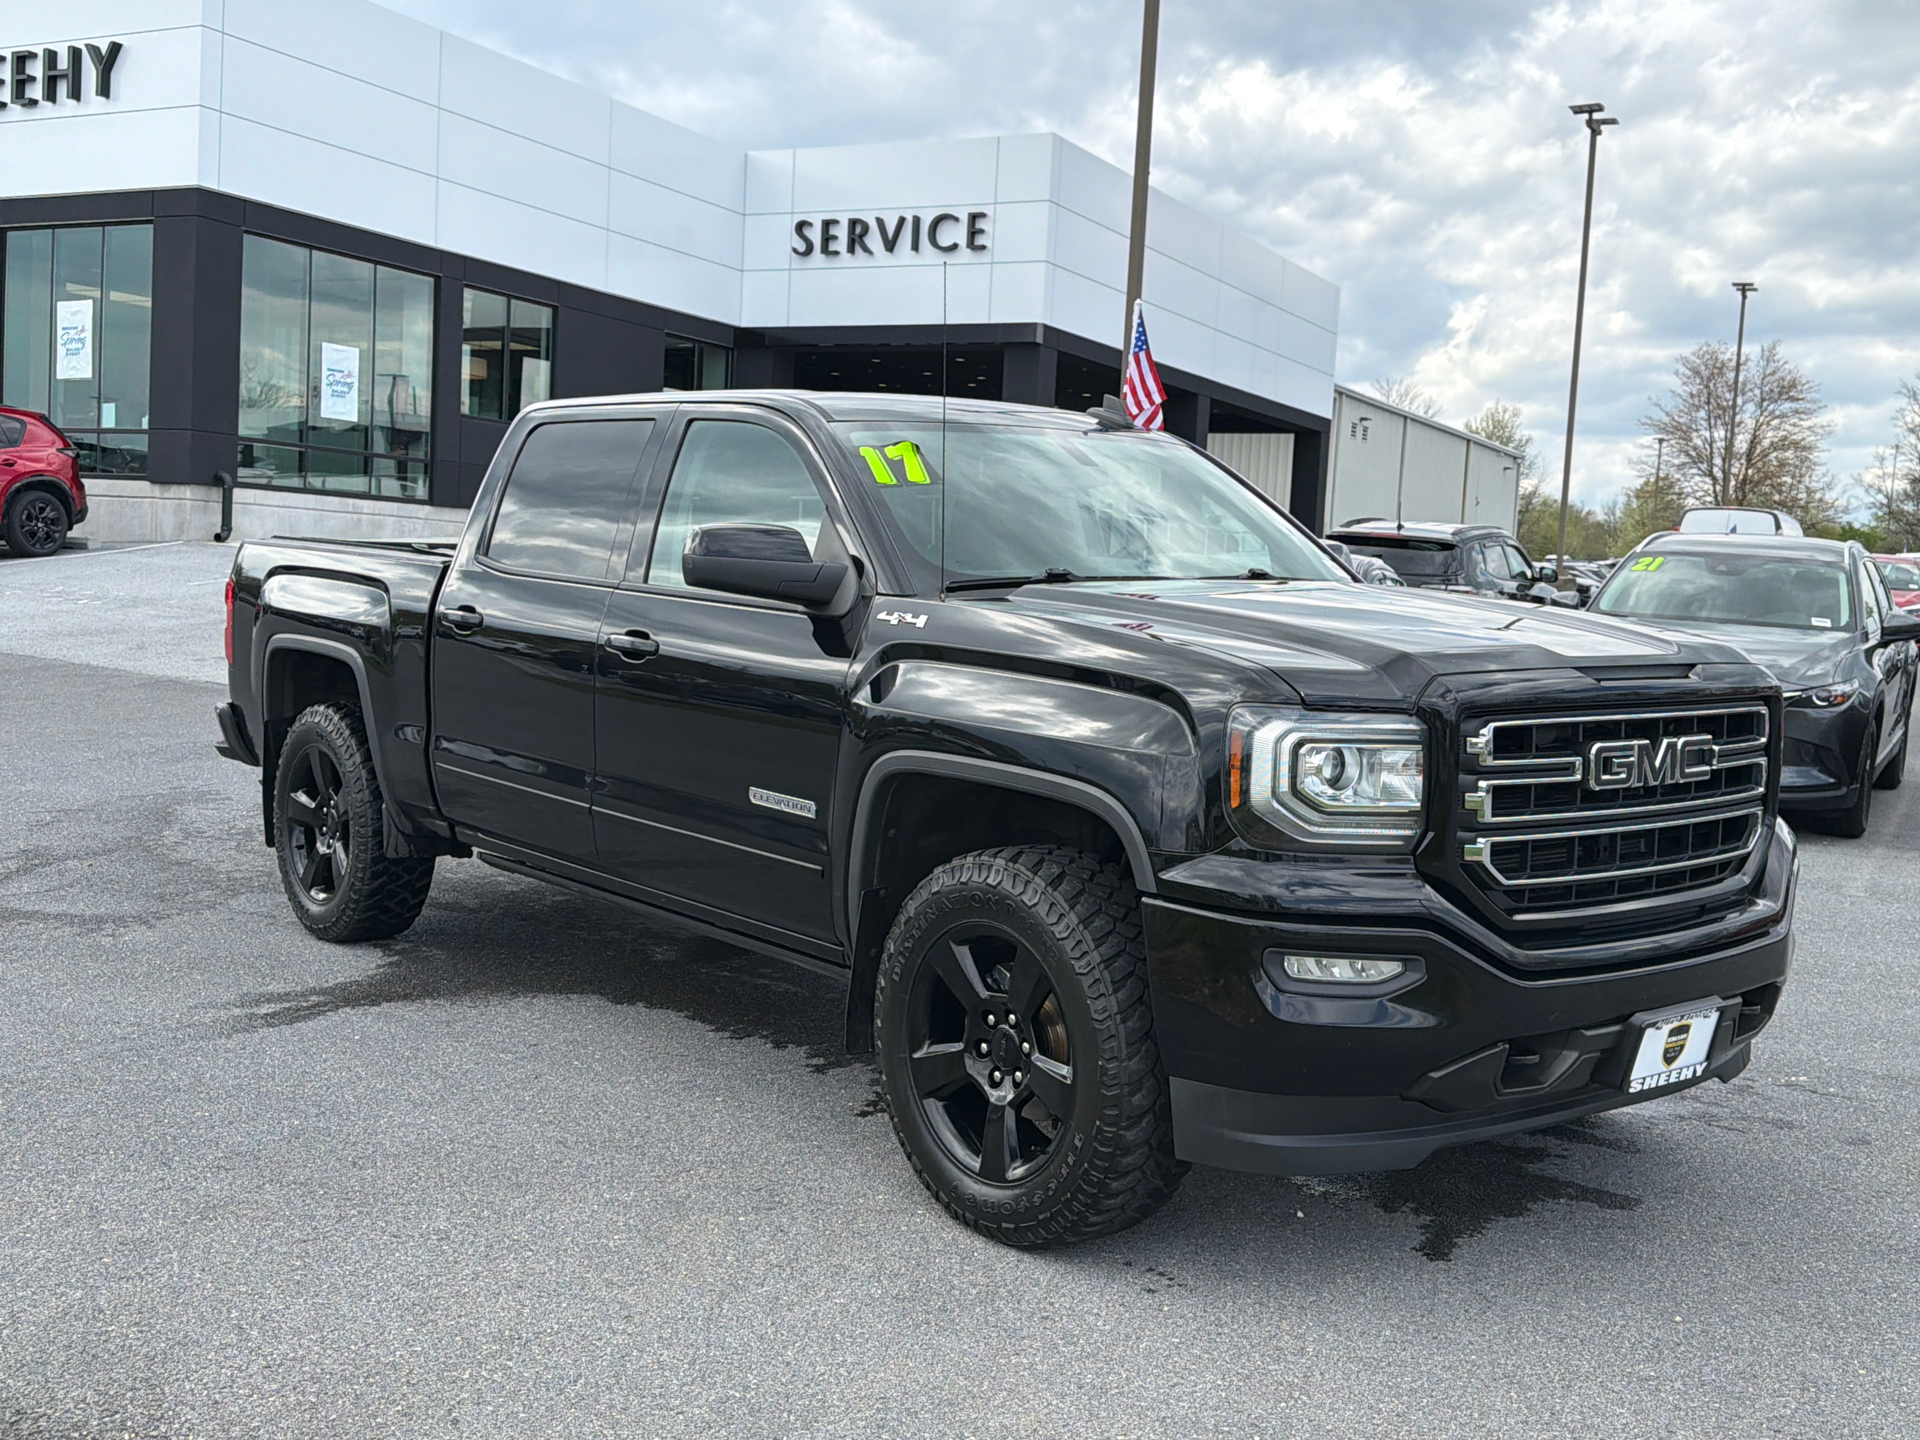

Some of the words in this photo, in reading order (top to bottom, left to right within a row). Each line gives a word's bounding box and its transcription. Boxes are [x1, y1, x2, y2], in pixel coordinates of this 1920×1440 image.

[0, 41, 123, 108] EHY
[792, 212, 988, 257] SERVICE
[61, 332, 87, 350] Spring
[326, 373, 354, 394] Spring
[860, 441, 931, 485] 17
[1630, 556, 1665, 571] 21
[1588, 734, 1713, 791] GMC
[753, 791, 812, 813] ELEVATION
[1628, 1061, 1709, 1093] SHEEHY
